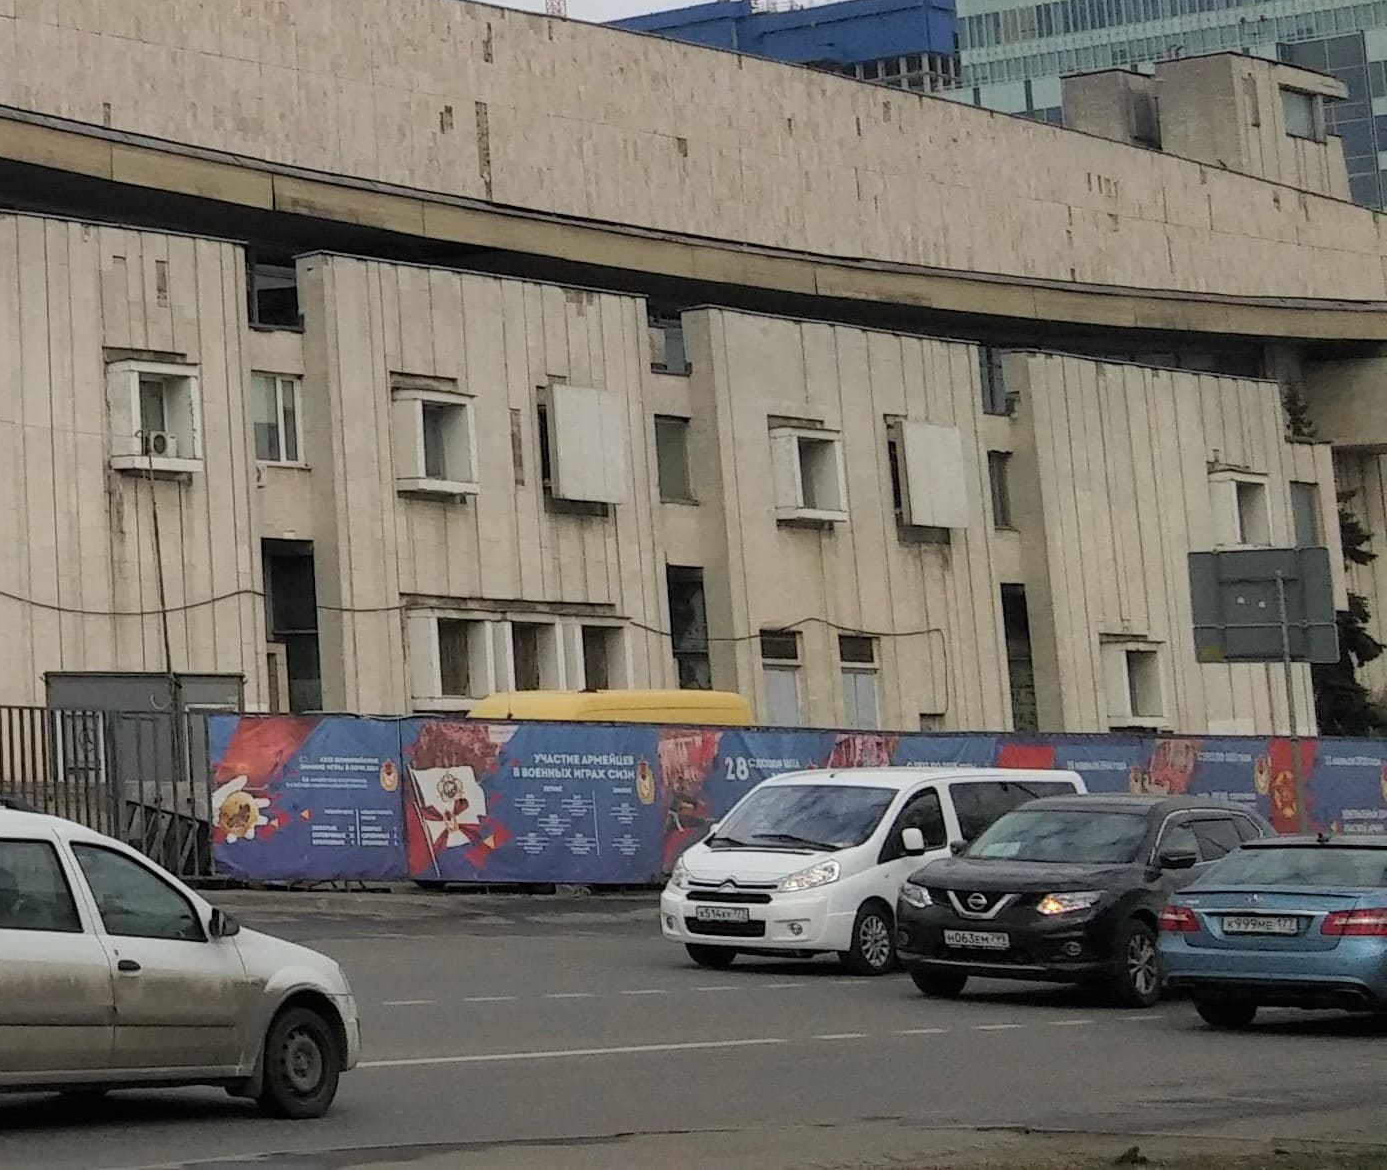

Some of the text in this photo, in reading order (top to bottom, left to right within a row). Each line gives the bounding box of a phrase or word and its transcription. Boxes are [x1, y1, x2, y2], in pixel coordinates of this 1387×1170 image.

[534, 753, 635, 766] УЧАСТИЕ АРМЕЙЦЕВ
[513, 768, 521, 778] В
[522, 767, 573, 779] ВОЕННЫХ
[574, 768, 606, 780] ИГРАХ
[724, 756, 750, 781] 28
